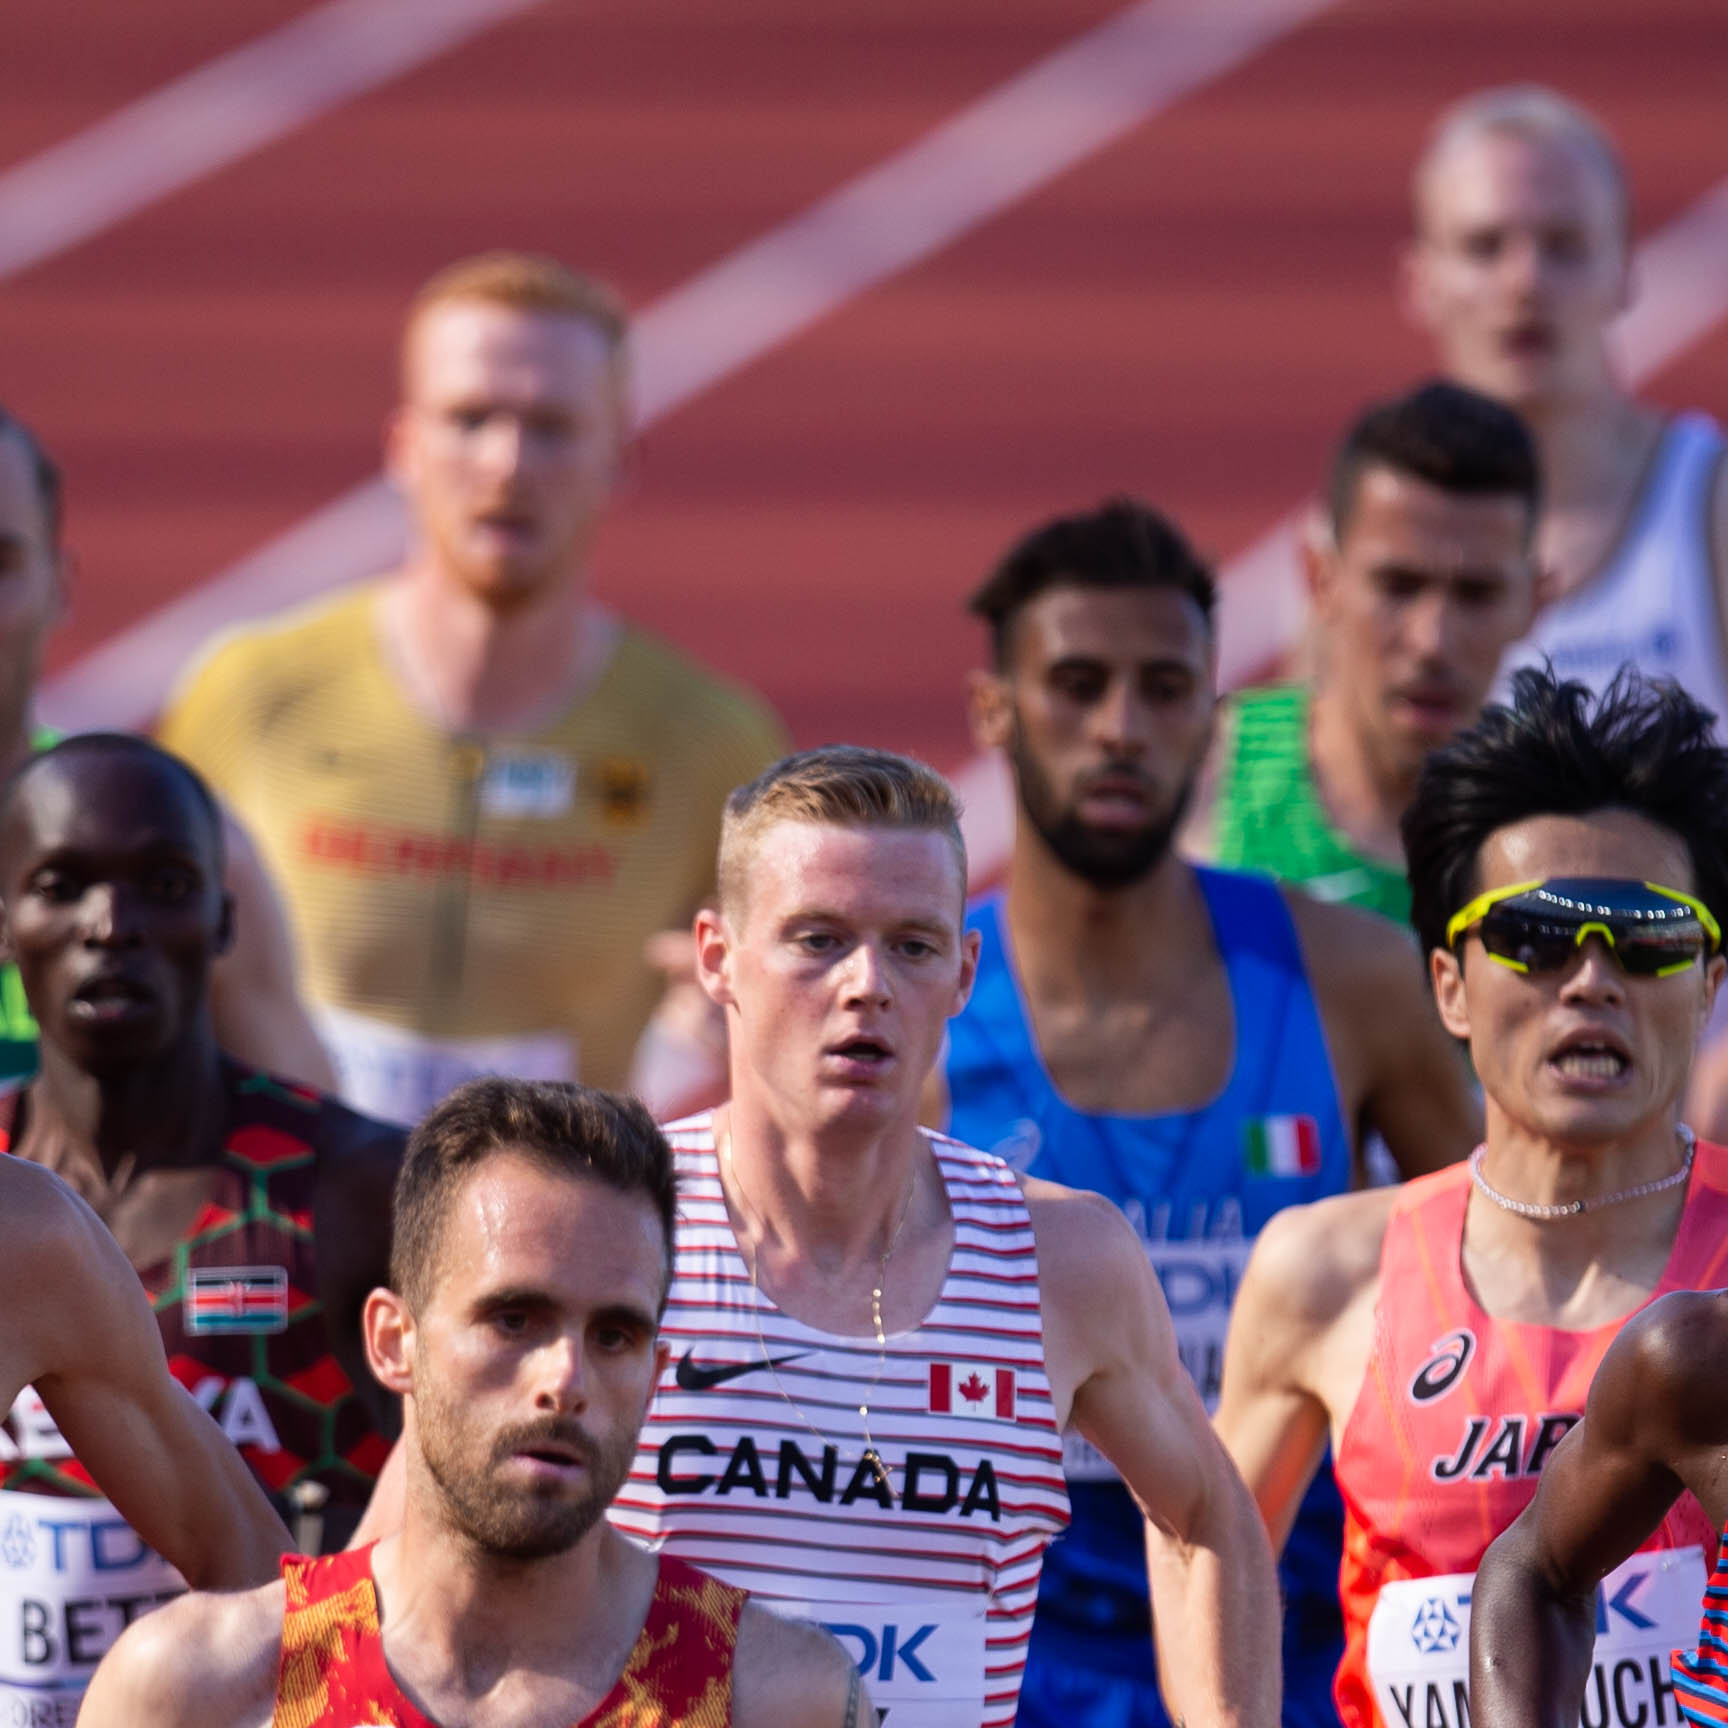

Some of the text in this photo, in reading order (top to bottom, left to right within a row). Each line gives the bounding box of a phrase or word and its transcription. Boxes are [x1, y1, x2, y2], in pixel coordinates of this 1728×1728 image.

[1434, 1414, 1585, 1478] JAP
[657, 1435, 1000, 1522] CANADA
[38, 1515, 172, 1573] TD
[23, 1587, 190, 1667] BET
[824, 1622, 940, 1682] DK
